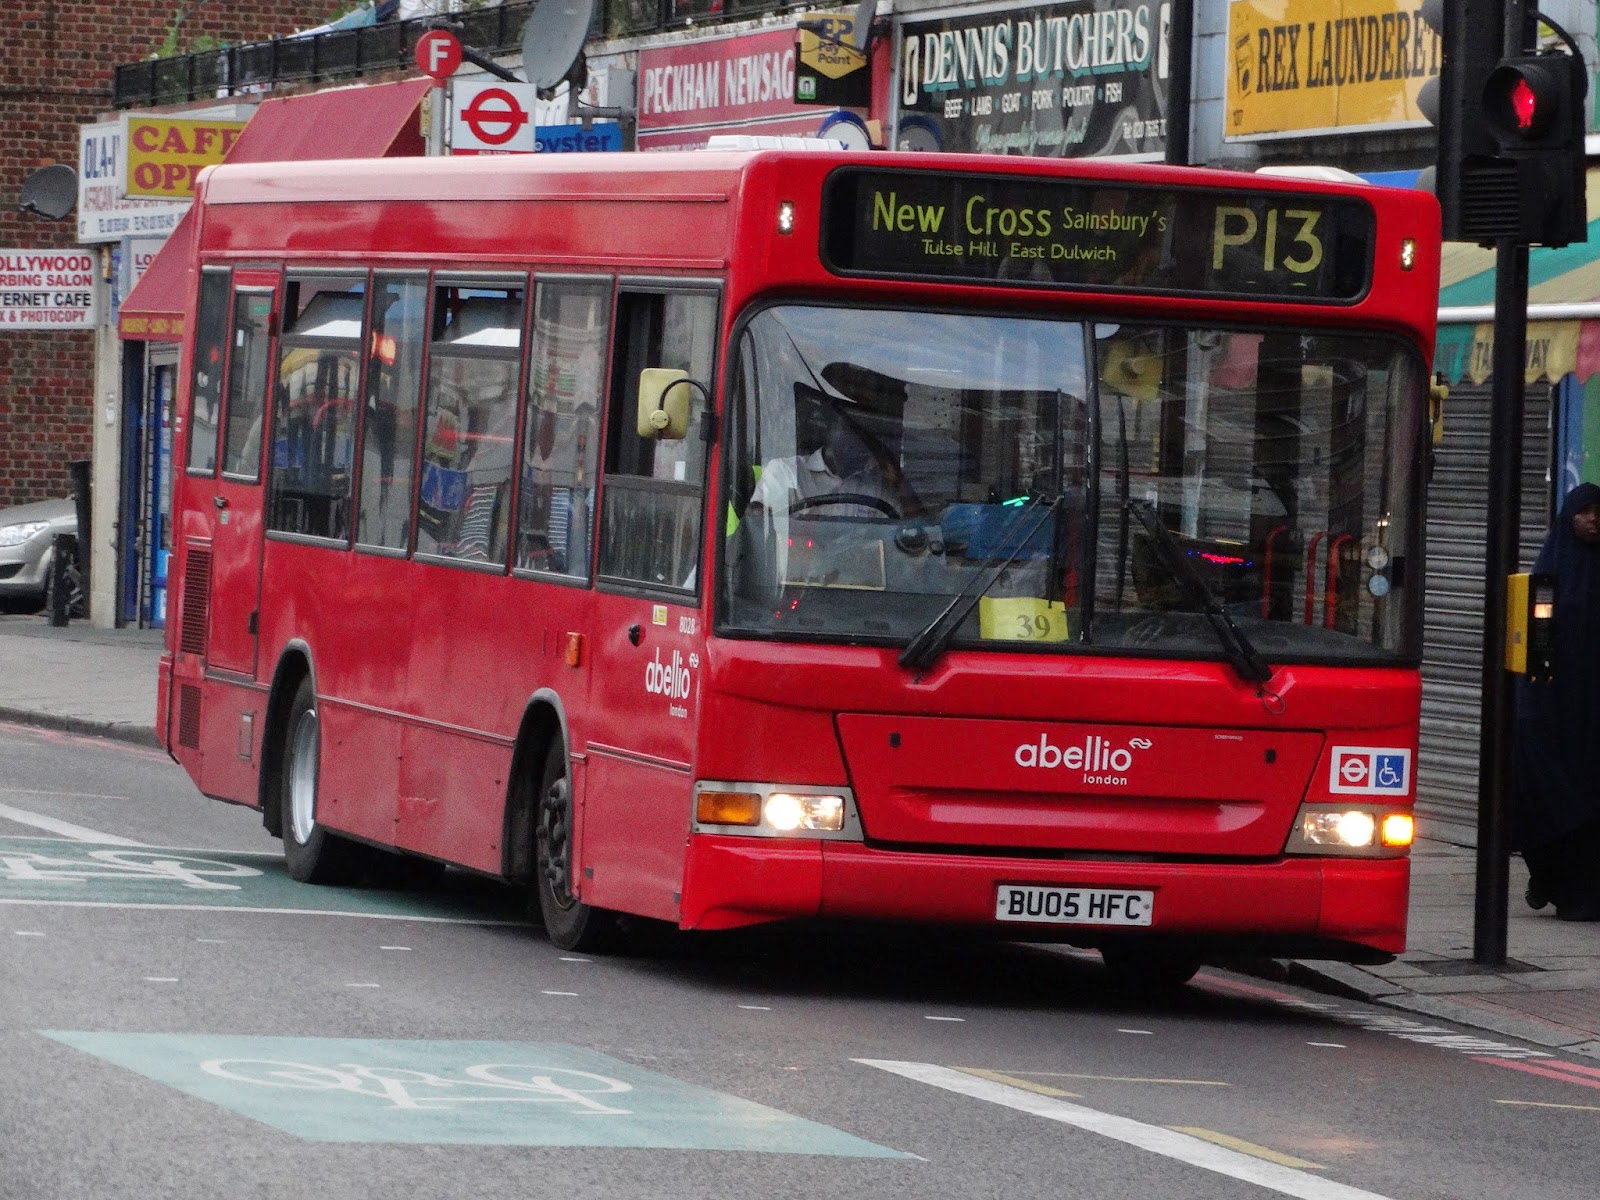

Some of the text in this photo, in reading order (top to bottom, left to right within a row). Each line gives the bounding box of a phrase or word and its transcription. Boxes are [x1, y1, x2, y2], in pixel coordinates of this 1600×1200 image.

[429, 39, 451, 72] F
[817, 53, 851, 65] Point
[1016, 5, 1150, 82] BUTCHERS
[1256, 24, 1301, 93] REX
[643, 49, 794, 115] PECKHAM NEWSAG
[944, 82, 1123, 118] BEEF LAMB GOAT PORK POULTRY FISH
[873, 191, 1167, 238] New Cross Sainsbury's
[921, 239, 1116, 261] Tulse Hill East Dulwich
[1212, 206, 1324, 273] P13
[46, 274, 92, 287] SALON
[54, 292, 91, 307] CAFE
[9, 310, 17, 322] &
[20, 310, 86, 323] PHOTOCOPY
[1016, 614, 1051, 639] 39
[645, 646, 691, 699] abellio
[669, 703, 688, 719] london
[1014, 733, 1132, 772] abellio
[1083, 773, 1128, 786] london
[1007, 890, 1142, 920] BU05 HFC
